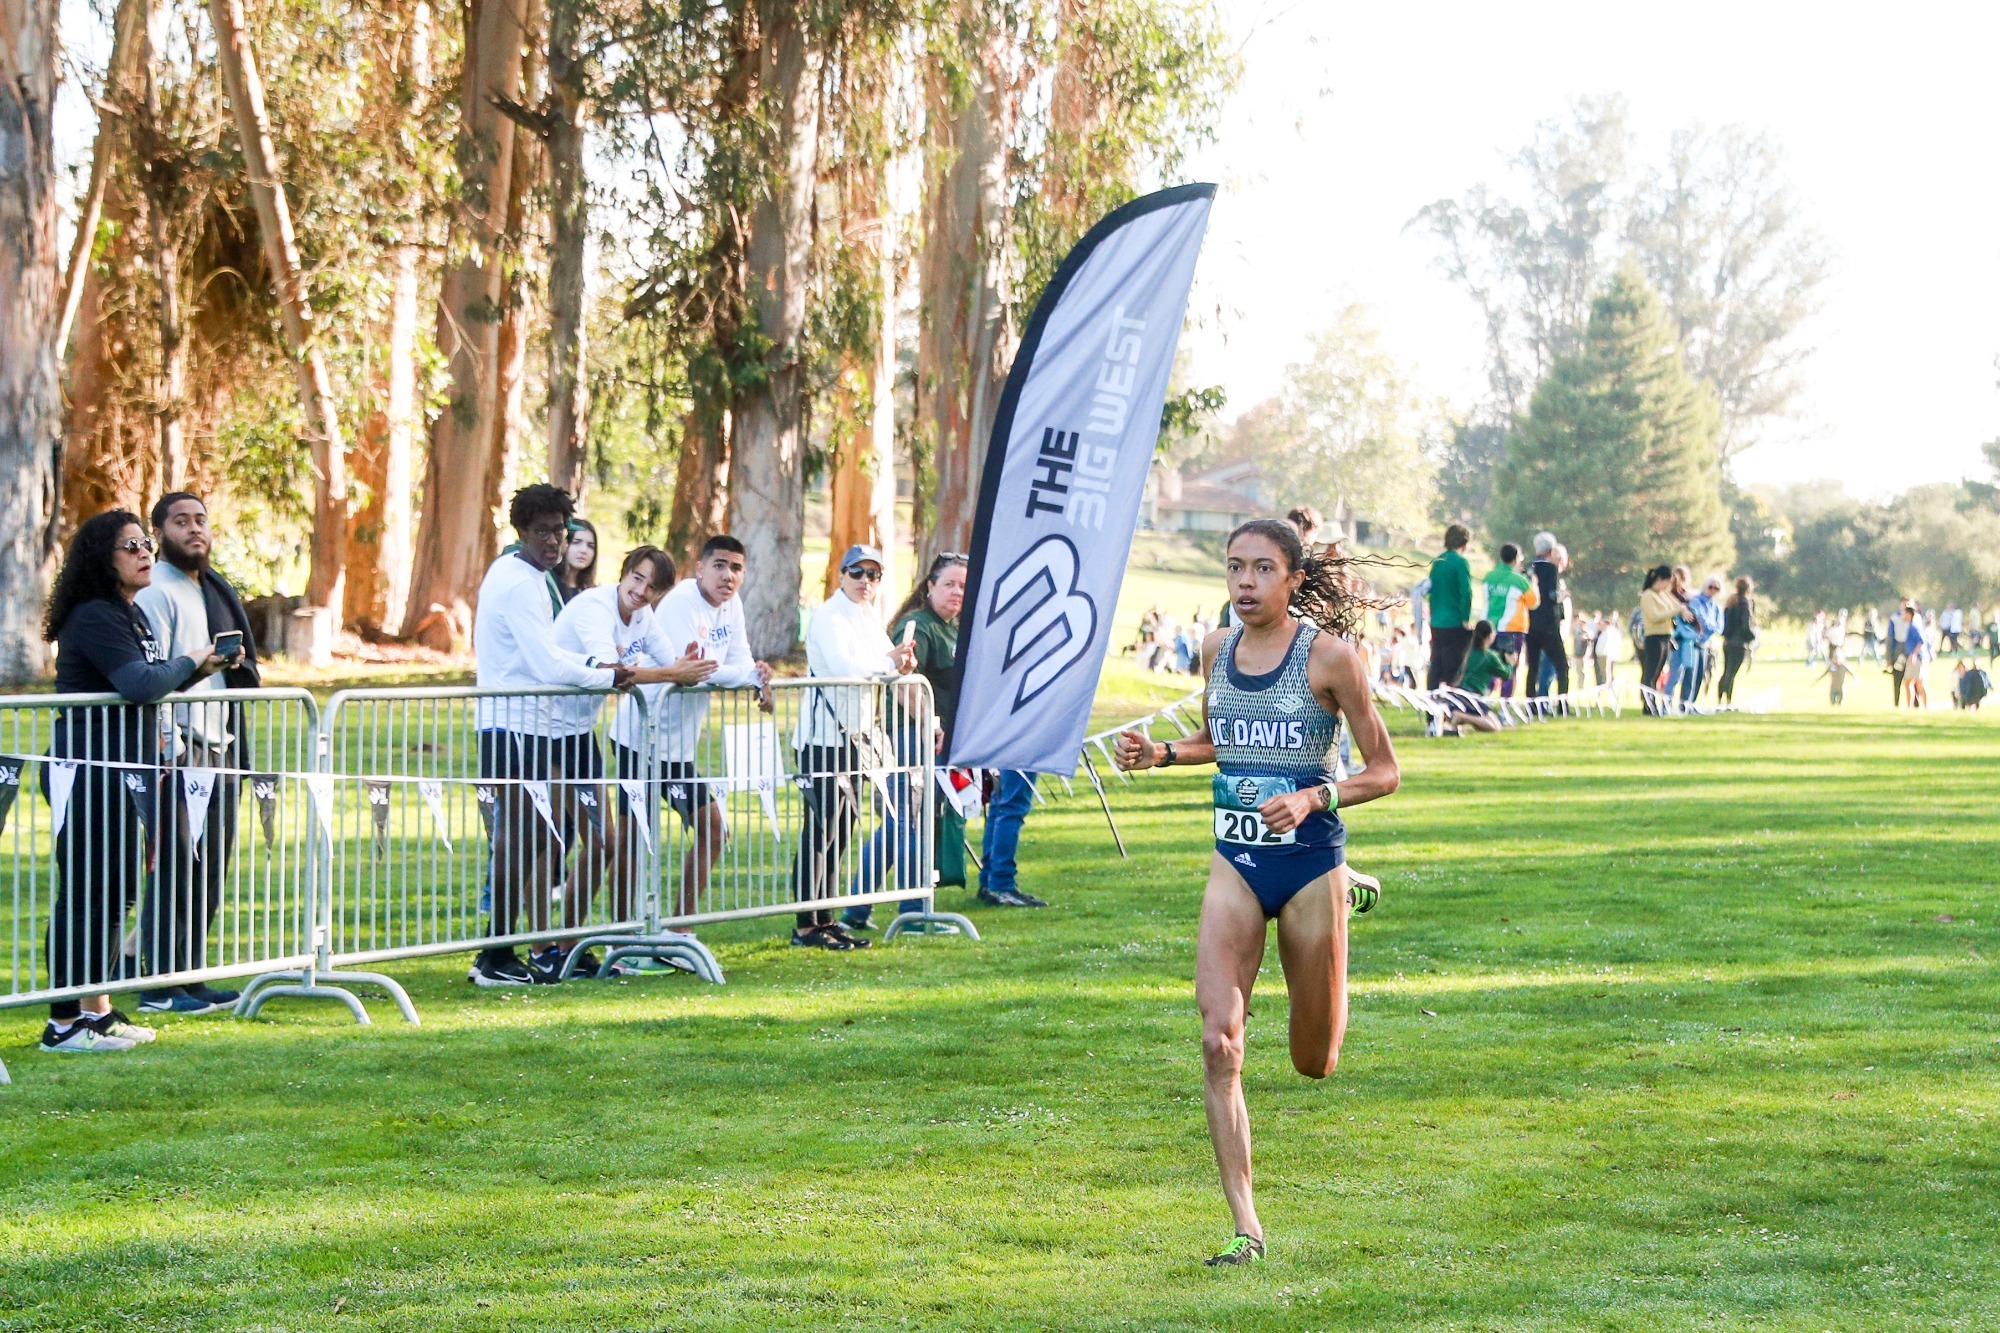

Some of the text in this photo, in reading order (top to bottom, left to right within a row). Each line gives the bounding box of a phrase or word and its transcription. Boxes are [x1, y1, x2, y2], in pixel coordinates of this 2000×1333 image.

[1066, 305, 1147, 532] BIG WEST
[1025, 427, 1080, 519] THE
[1207, 717, 1304, 750] UC DAVIS
